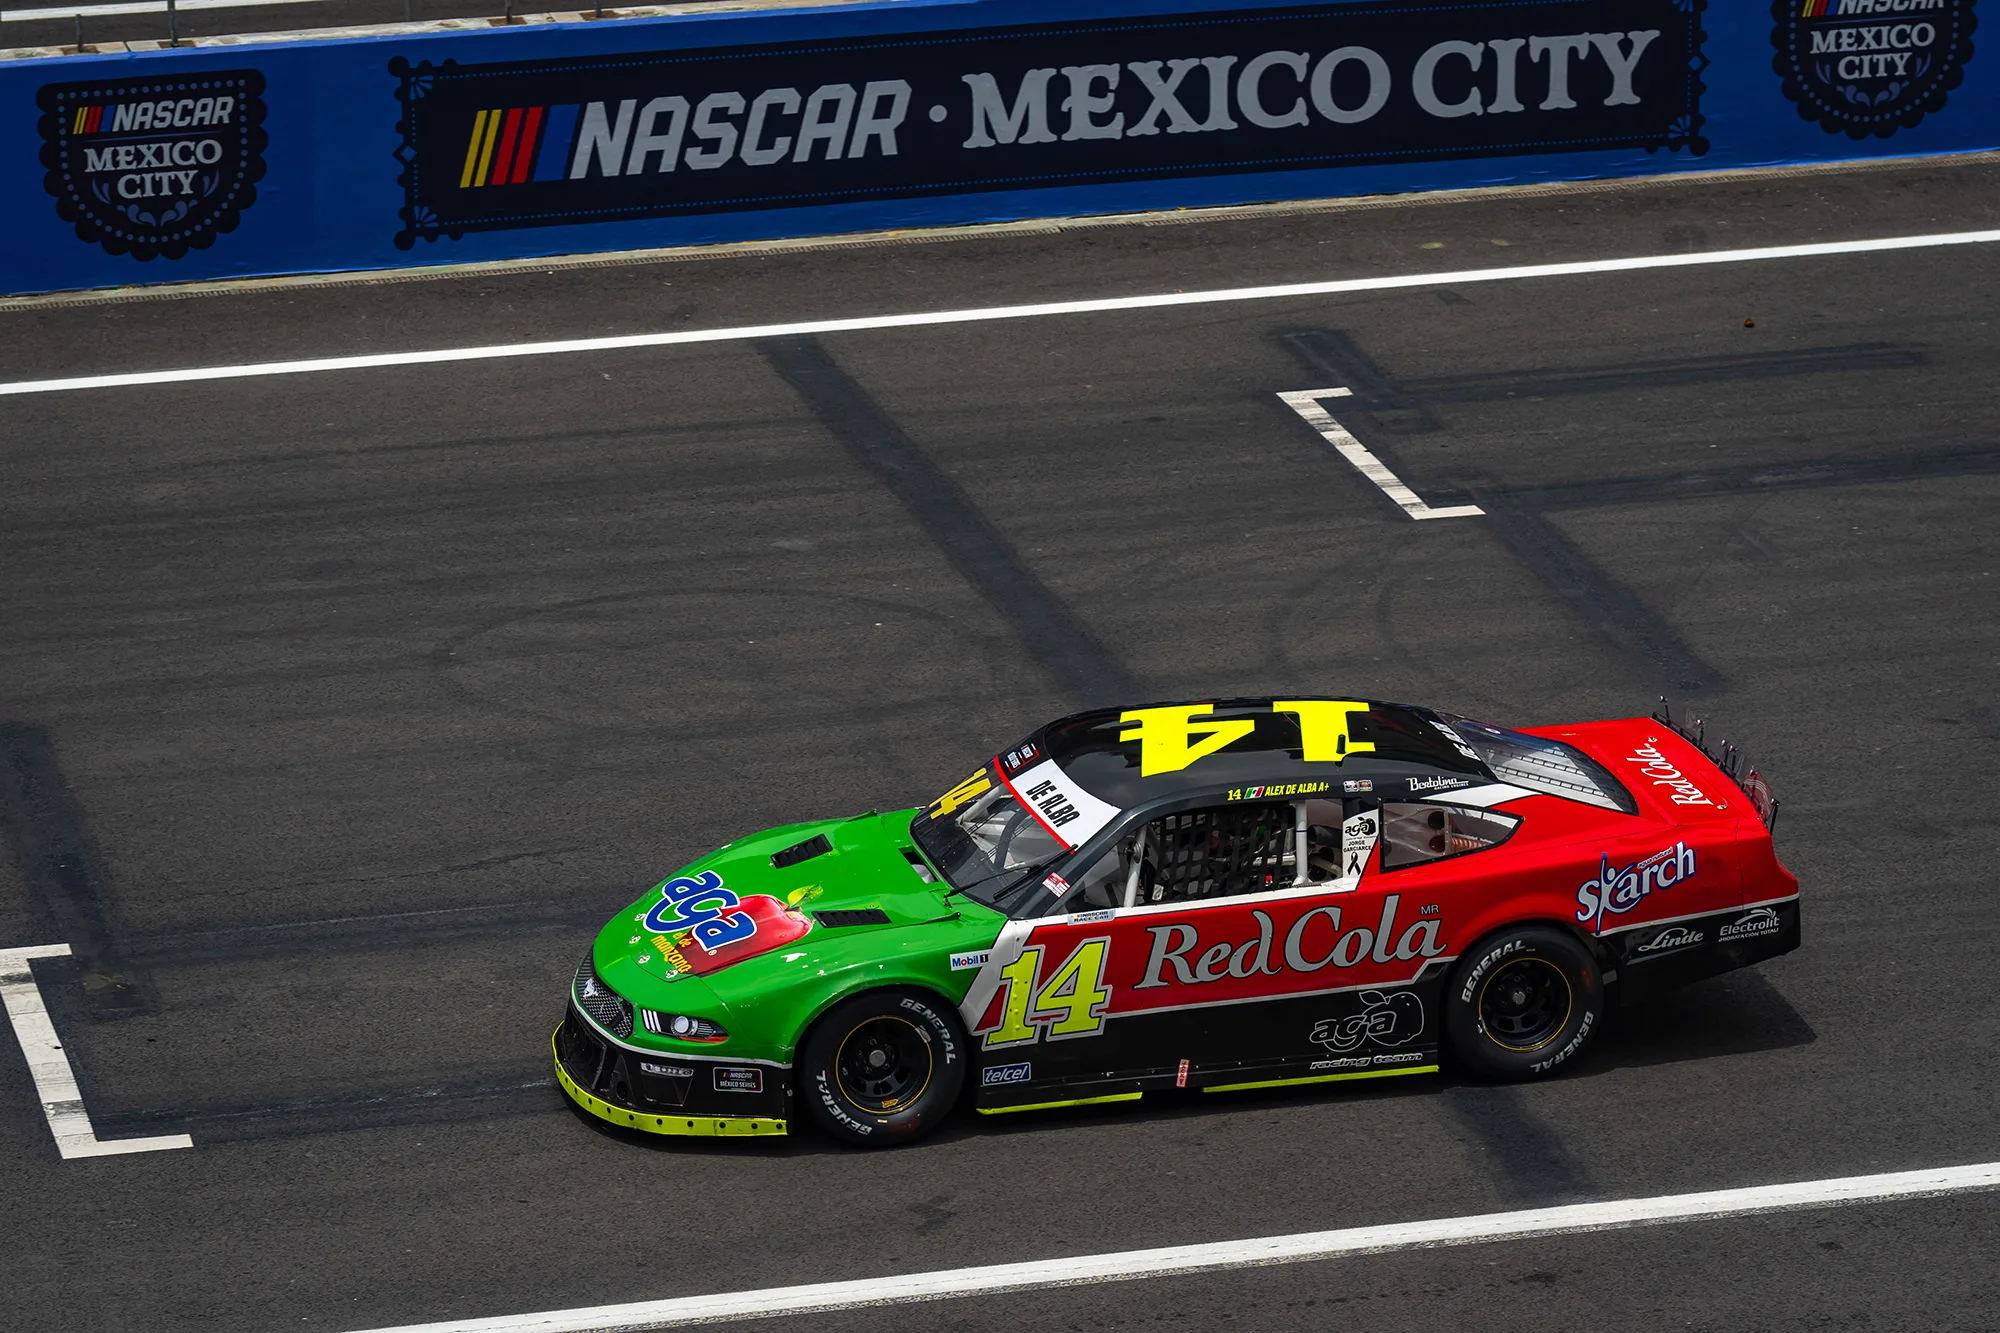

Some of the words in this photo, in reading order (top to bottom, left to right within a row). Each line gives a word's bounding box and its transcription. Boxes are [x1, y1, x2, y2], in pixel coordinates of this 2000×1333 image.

[1809, 22, 1936, 54] MEXICO
[1837, 52, 1912, 80] CITY
[112, 96, 235, 132] NASCAR
[569, 79, 912, 180] NASCAR
[961, 45, 1392, 149] MEXICO
[1411, 29, 1660, 118] CITY
[83, 139, 223, 172] MEXICO
[117, 169, 199, 199] CITY
[1118, 700, 1376, 778] 14
[1025, 779, 1057, 802] DE
[1227, 788, 1242, 801] 14
[1264, 785, 1285, 797] ALEX
[1285, 784, 1297, 795] DE
[1297, 782, 1317, 794] ALBA
[1318, 781, 1330, 792] A+
[1037, 793, 1081, 828] ALBA
[1344, 822, 1368, 837] aga
[643, 870, 757, 952] aga
[1420, 904, 1440, 915] MR
[1637, 927, 1704, 952] Linde
[1719, 916, 1780, 936] Electrolit
[951, 955, 979, 967] Mobil
[1461, 940, 1526, 1003] GENERAL
[982, 935, 1113, 1051] 14
[899, 998, 956, 1065] GENERAL
[1309, 1010, 1397, 1053] aga
[1530, 1011, 1594, 1073] GENERAL
[985, 1065, 1029, 1083] telcel
[1309, 1057, 1371, 1070] racing
[1373, 1052, 1423, 1064] team
[816, 1069, 873, 1136] GENERAL
